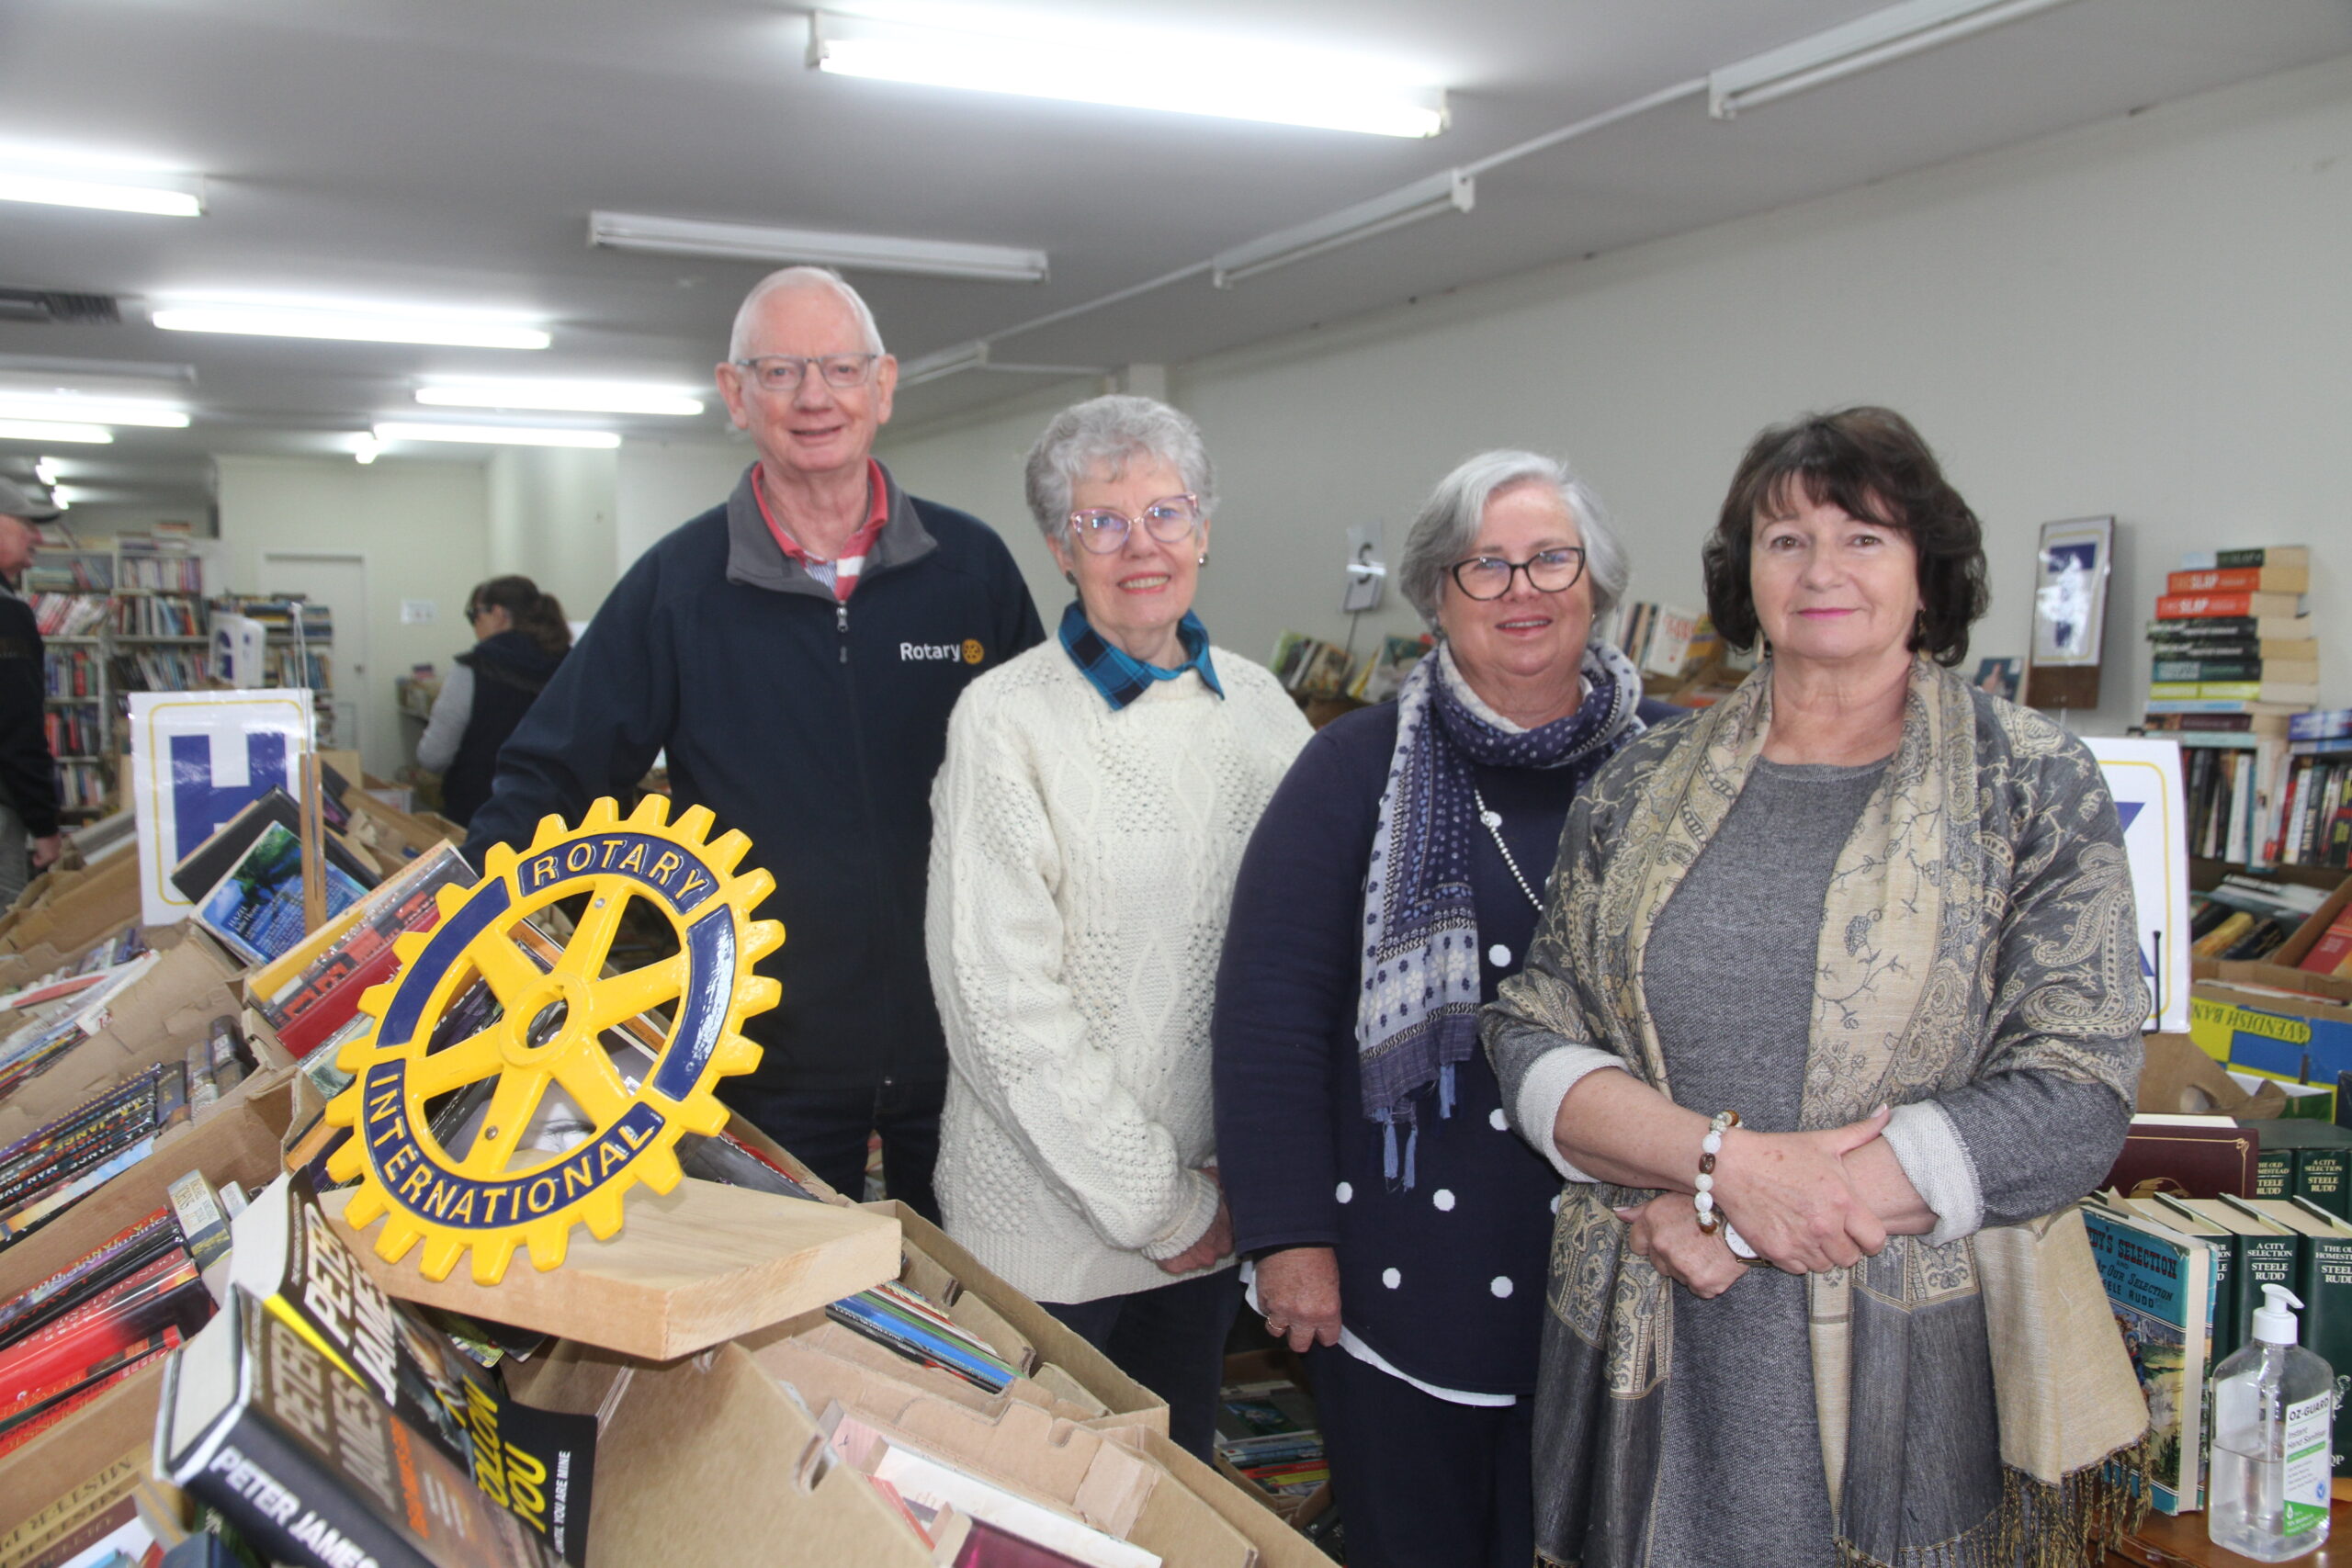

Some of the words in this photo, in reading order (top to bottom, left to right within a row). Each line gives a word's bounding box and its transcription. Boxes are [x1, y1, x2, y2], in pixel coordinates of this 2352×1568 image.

[899, 642, 960, 662] Rotary
[533, 840, 706, 903] ROTARY
[2227, 1010, 2308, 1041] AVENDISH
[368, 1073, 656, 1224] INTERNATIONAL
[2257, 1179, 2284, 1187] TEELE
[2118, 1238, 2177, 1280] SELECTION
[2251, 1263, 2289, 1271] STEELE
[2321, 1265, 2352, 1274] STEEL
[304, 1201, 352, 1348] PETER
[2255, 1272, 2286, 1280] RUDD
[2129, 1291, 2154, 1308] RUDD
[270, 1319, 332, 1457] PETER
[2289, 1396, 2329, 1422] OZ-GUARD
[465, 1374, 511, 1508] OLLOW
[558, 1450, 571, 1480] MINE
[209, 1445, 300, 1527] PETER
[505, 1441, 548, 1535] YOU
[555, 1480, 569, 1504] ARE
[554, 1501, 565, 1525] YOU
